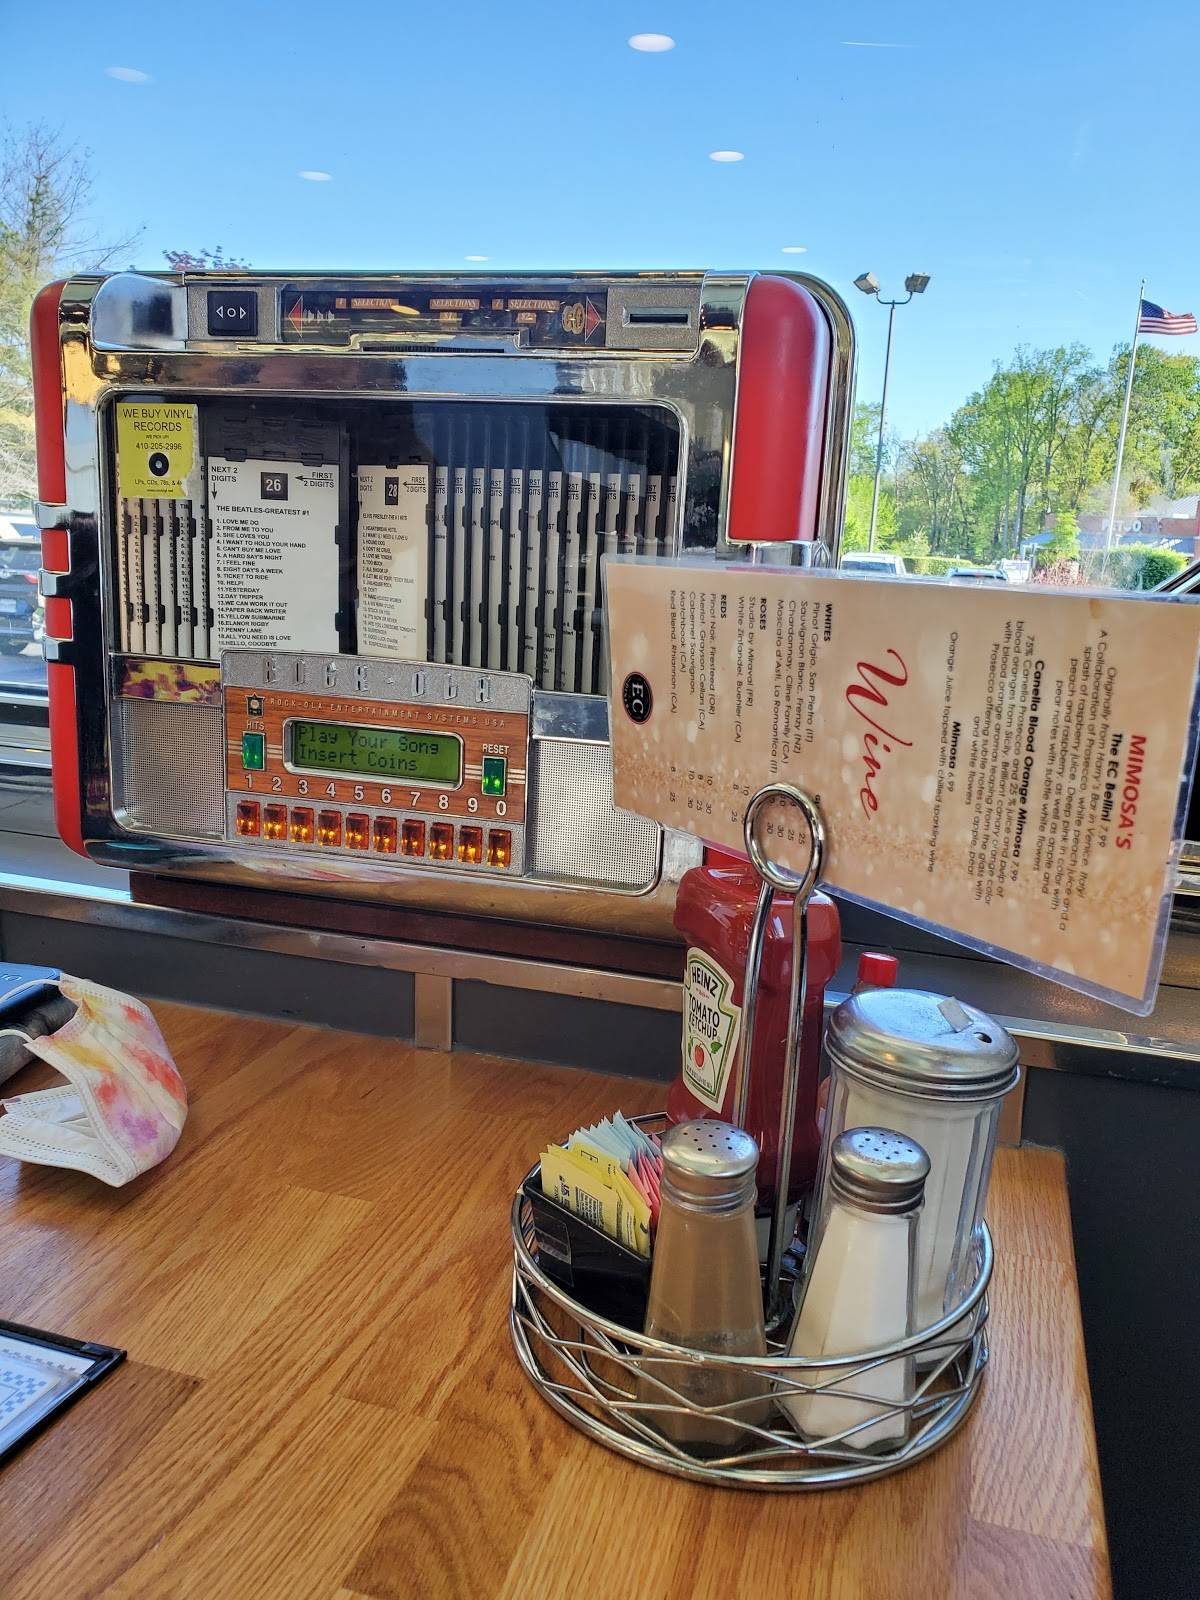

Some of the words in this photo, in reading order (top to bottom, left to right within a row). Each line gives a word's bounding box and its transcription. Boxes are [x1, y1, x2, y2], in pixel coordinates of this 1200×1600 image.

[123, 408, 138, 418] WE
[142, 408, 160, 418] BUY
[164, 409, 192, 418] VINYL
[134, 422, 182, 432] RECORDS
[136, 442, 182, 450] 410-205-2996
[211, 466, 232, 474] NEXT
[265, 478, 282, 492] 26
[388, 484, 398, 498] 28
[232, 506, 300, 516] BEATLES-GREATEST
[748, 596, 756, 630] Studio
[776, 600, 784, 647] Moscato
[812, 602, 820, 630] Pinot
[824, 604, 832, 642] WHITES
[747, 632, 754, 646] by
[797, 600, 808, 659] Sauvignon
[1100, 630, 1108, 638] A
[698, 630, 706, 671] Grayson
[947, 631, 959, 672] Orange
[670, 644, 678, 690] Rhiannon
[746, 648, 754, 686] Miraval
[698, 674, 706, 706] Cellars
[774, 685, 781, 698] La
[784, 675, 793, 702] Cline
[808, 672, 816, 692] San
[944, 675, 954, 702] Juice
[1030, 660, 1045, 712] Canella
[1088, 642, 1107, 720] Collaboration
[1100, 666, 1117, 721] Originally
[632, 682, 644, 714] EC
[670, 692, 678, 714] (CA)
[708, 694, 716, 716] (OR)
[746, 688, 754, 707] (FR)
[806, 695, 816, 726] Pietro
[246, 720, 264, 731] HITS
[270, 698, 322, 708] ROCK-OLA
[330, 702, 420, 718] ENTERTAINMENT
[426, 712, 478, 725] SYSTEMS
[484, 718, 506, 728] USA
[698, 708, 706, 730] (CA)
[782, 705, 792, 738] Family
[794, 698, 804, 730] Frenzy
[939, 705, 952, 744] topped
[300, 726, 338, 744] Play
[348, 730, 387, 748] Your
[398, 736, 439, 755] Song
[734, 720, 742, 744] (CA)
[771, 700, 780, 757] Romantica
[805, 728, 814, 744] (IT)
[845, 648, 913, 821] Wine
[1025, 716, 1039, 753] Blood
[1087, 724, 1097, 736] of
[1098, 723, 1110, 750] from
[300, 744, 358, 764] Insert
[368, 752, 418, 771] Coins
[482, 744, 510, 756] RESET
[781, 741, 790, 764] (CA)
[792, 734, 802, 754] (NZ)
[938, 746, 948, 767] with
[948, 721, 962, 770] Mimosa
[1110, 733, 1123, 756] The
[770, 760, 778, 774] (IT)
[1018, 756, 1033, 805] Orange
[1091, 752, 1105, 790] Harry's
[1107, 760, 1122, 778] EC
[706, 776, 713, 786] 10
[934, 770, 945, 803] chilled
[946, 772, 954, 792] 6.99
[1116, 734, 1147, 850] MIMOSA'S
[245, 774, 254, 788] 1
[272, 776, 282, 792] 2
[298, 780, 308, 794] 3
[326, 782, 336, 798] 4
[354, 786, 364, 801] 5
[381, 788, 392, 804] 6
[410, 792, 421, 806] 7
[438, 794, 449, 810] 8
[468, 798, 478, 812] 9
[496, 800, 507, 816] 0
[706, 802, 712, 814] 30
[1089, 793, 1099, 811] Bar
[1100, 782, 1116, 822] Bellini
[731, 810, 738, 822] 25
[1074, 796, 1086, 827] white
[1088, 814, 1097, 824] in
[929, 804, 942, 848] sparkling
[1012, 808, 1028, 858] Mimosa
[1098, 824, 1108, 848] 7.99
[928, 849, 937, 873] wine
[1070, 830, 1082, 866] peach
[1010, 860, 1018, 882] 7.99
[1064, 868, 1076, 896] juice
[1060, 898, 1071, 920] and
[1058, 922, 1066, 931] a
[692, 966, 718, 997] HEINZ
[688, 993, 720, 1028] TOMATO
[688, 1012, 718, 1038] KETCHUP
